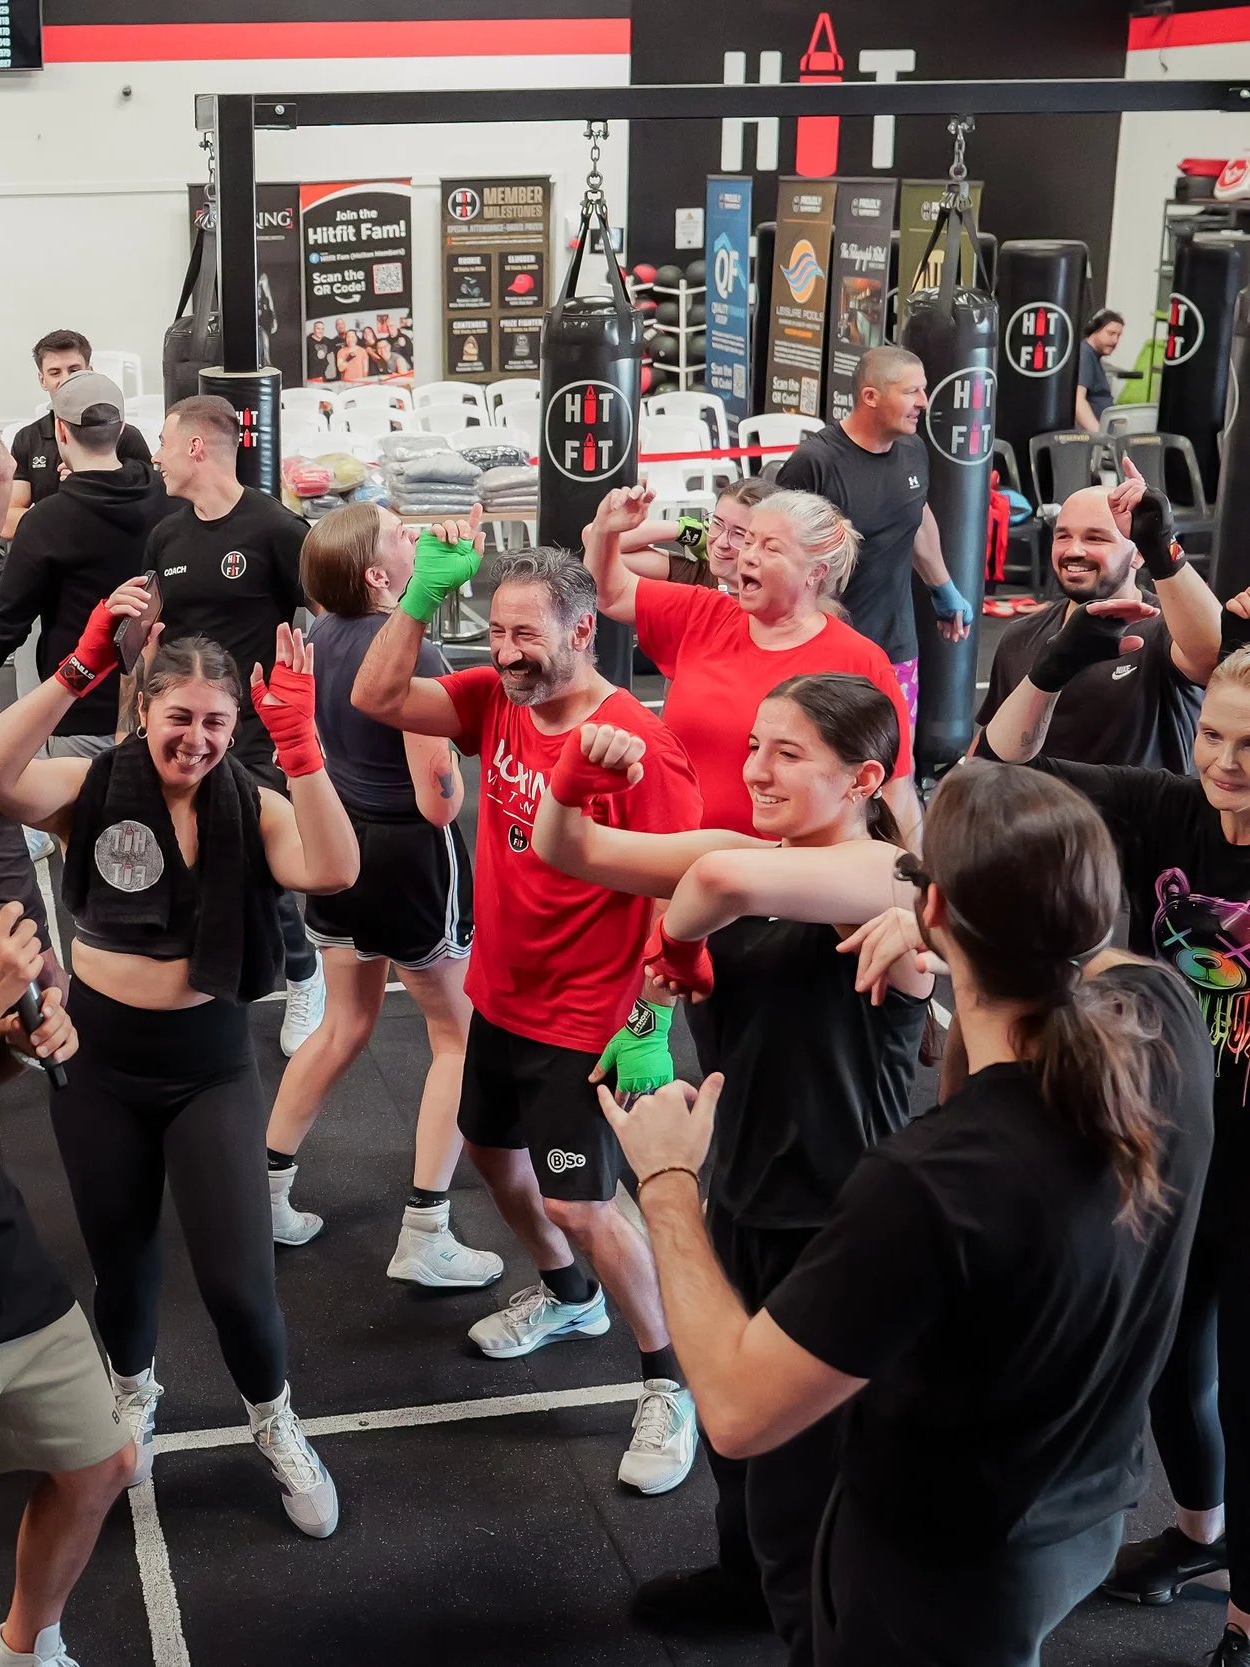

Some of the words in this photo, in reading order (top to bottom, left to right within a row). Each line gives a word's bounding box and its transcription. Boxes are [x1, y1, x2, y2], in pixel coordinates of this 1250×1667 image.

[483, 186, 543, 205] MEMBER
[336, 210, 358, 221] Join
[359, 208, 378, 219] the
[483, 205, 543, 219] MILESTONES
[308, 225, 357, 245] Hitfit
[361, 220, 406, 240] Fam!
[312, 272, 342, 284] Scan
[344, 269, 365, 281] the
[313, 284, 331, 295] QR
[333, 281, 366, 294] Code!
[776, 306, 802, 318] LEISURE
[803, 310, 824, 321] POOLS
[1022, 308, 1058, 336] HIT
[1169, 299, 1188, 327] IT
[1166, 332, 1185, 359] IT
[1020, 341, 1056, 370] FIT
[772, 376, 788, 391] Scan
[788, 378, 800, 392] the
[953, 375, 993, 409] HIT
[565, 385, 614, 424] HIT
[951, 419, 992, 454] FIT
[564, 433, 613, 471] FIT
[227, 553, 240, 564] HIT
[164, 565, 187, 577] COACH
[226, 565, 239, 576] FIT
